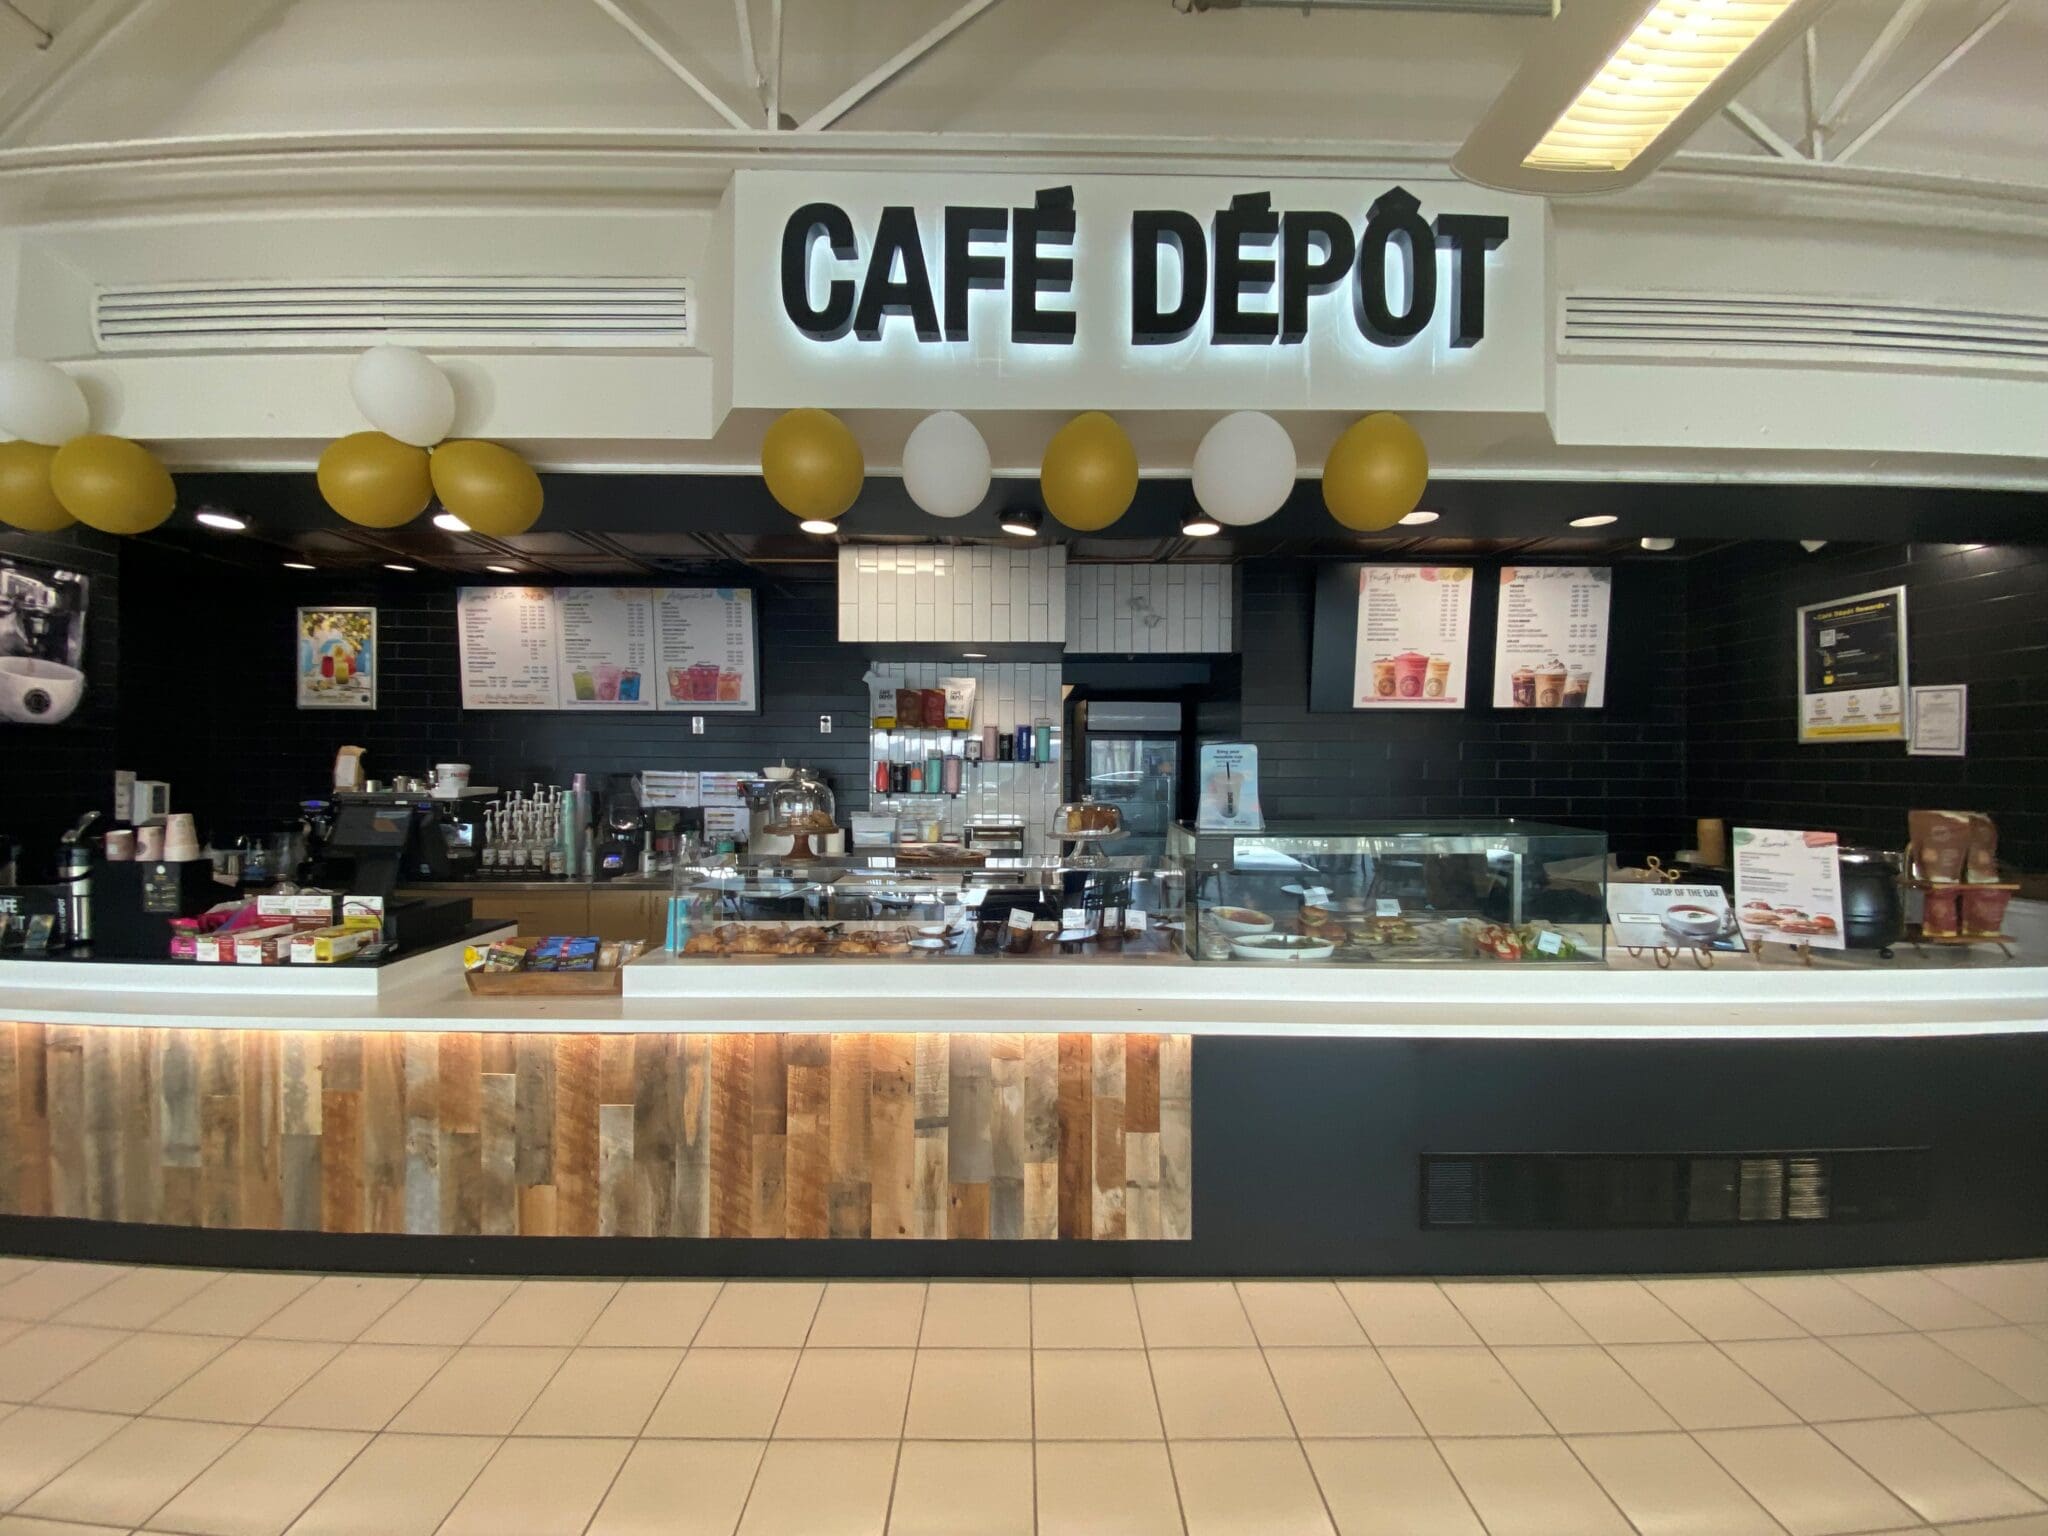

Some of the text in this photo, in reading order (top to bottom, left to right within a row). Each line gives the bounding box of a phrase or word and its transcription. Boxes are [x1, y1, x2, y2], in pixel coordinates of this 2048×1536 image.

[781, 185, 1509, 349] CAFÉ DÉPÔT
[1651, 887, 1719, 898] SOUP OF THE DAY
[0, 897, 18, 914] AFÉ
